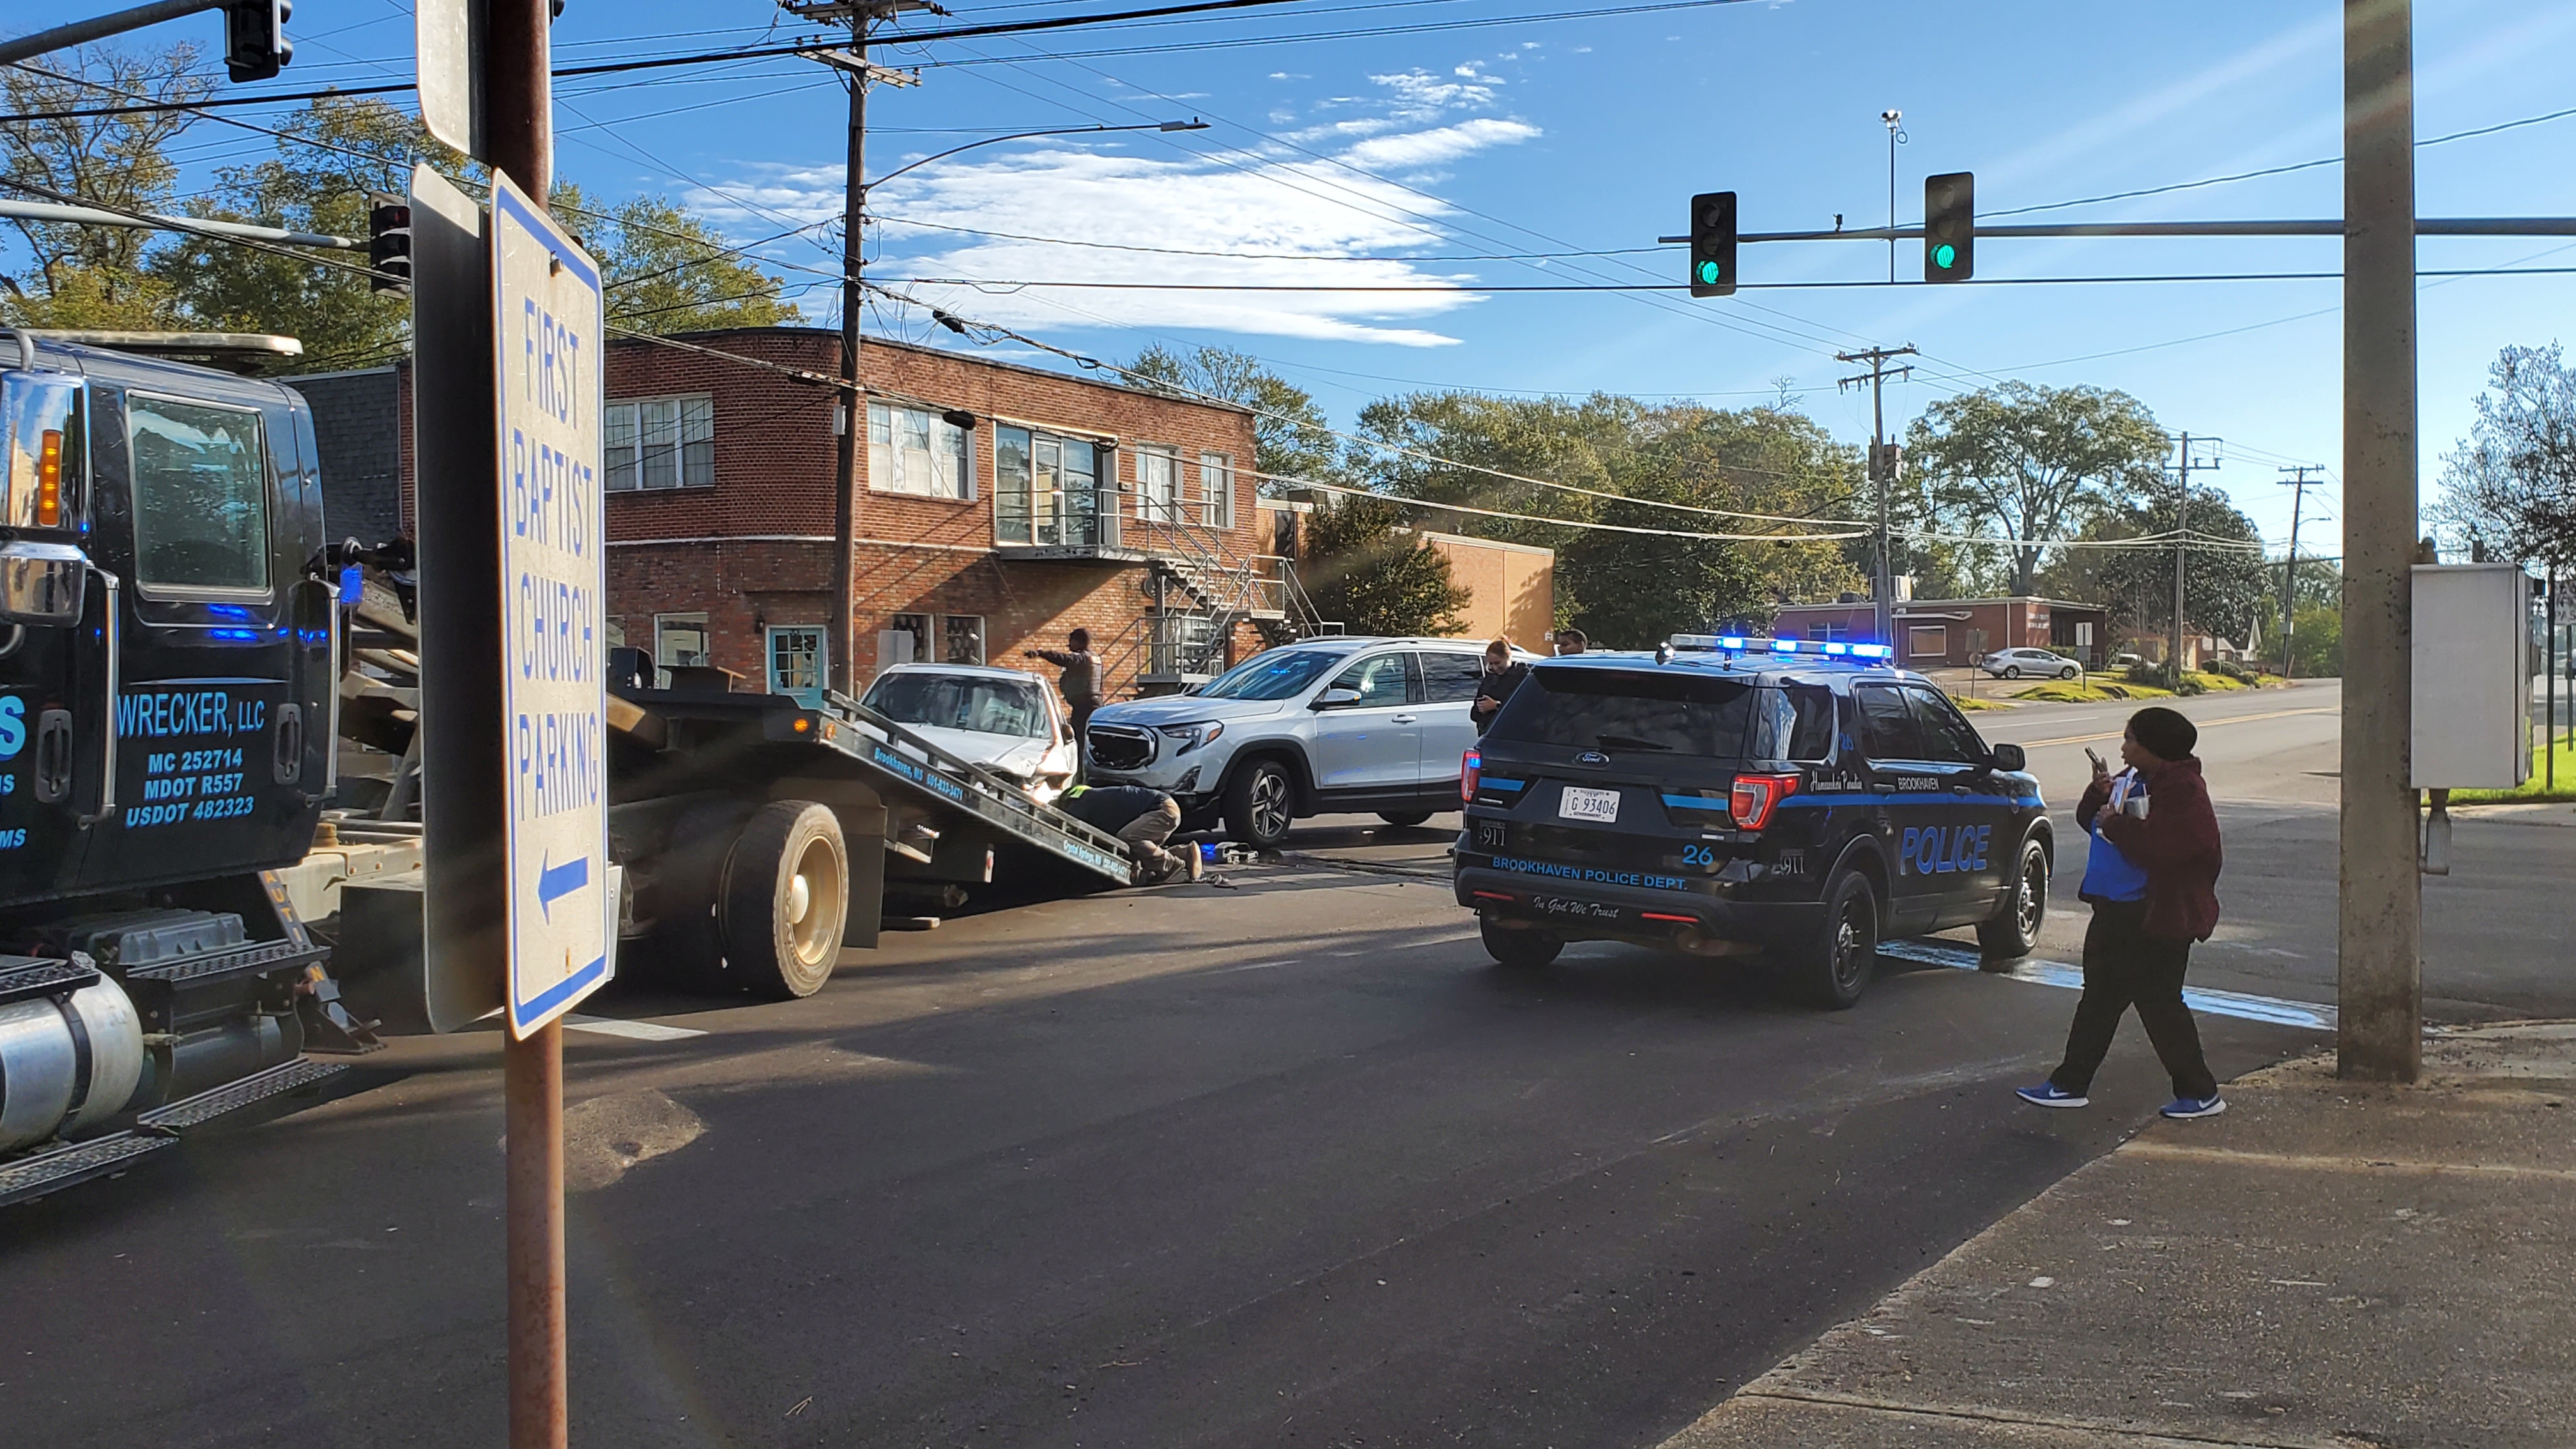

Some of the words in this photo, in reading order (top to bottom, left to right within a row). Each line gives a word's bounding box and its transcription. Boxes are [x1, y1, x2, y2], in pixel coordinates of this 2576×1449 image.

[525, 296, 579, 430] FIRST
[514, 427, 593, 560] BAPTIST
[521, 571, 594, 683] CHURCH
[117, 691, 233, 739] WRECKER,
[237, 700, 266, 732] LLC
[1839, 732, 1855, 751] 26
[148, 753, 176, 775] MC
[181, 747, 243, 772] 252714
[519, 711, 597, 822] PARKING
[874, 746, 913, 779] Brookhaven,
[144, 776, 197, 802] MDOT
[201, 773, 243, 796] R557
[1897, 777, 1940, 791] BROOKHAVEN
[125, 803, 189, 829] USDOT
[192, 796, 255, 822] 482323
[1572, 797, 1579, 811] G
[1583, 797, 1617, 815] 93406
[1483, 827, 1505, 847] 911
[1899, 825, 1991, 876] POLICE
[1682, 844, 1714, 866] 26
[1784, 855, 1804, 875] 911
[1492, 856, 1581, 880] BROOKHAVEN
[1584, 869, 1640, 886] POLICE
[1643, 875, 1688, 891] DEPT.
[1533, 896, 1545, 909] In
[1548, 900, 1569, 914] God
[1570, 901, 1587, 915] We
[1590, 903, 1620, 919] Trust
